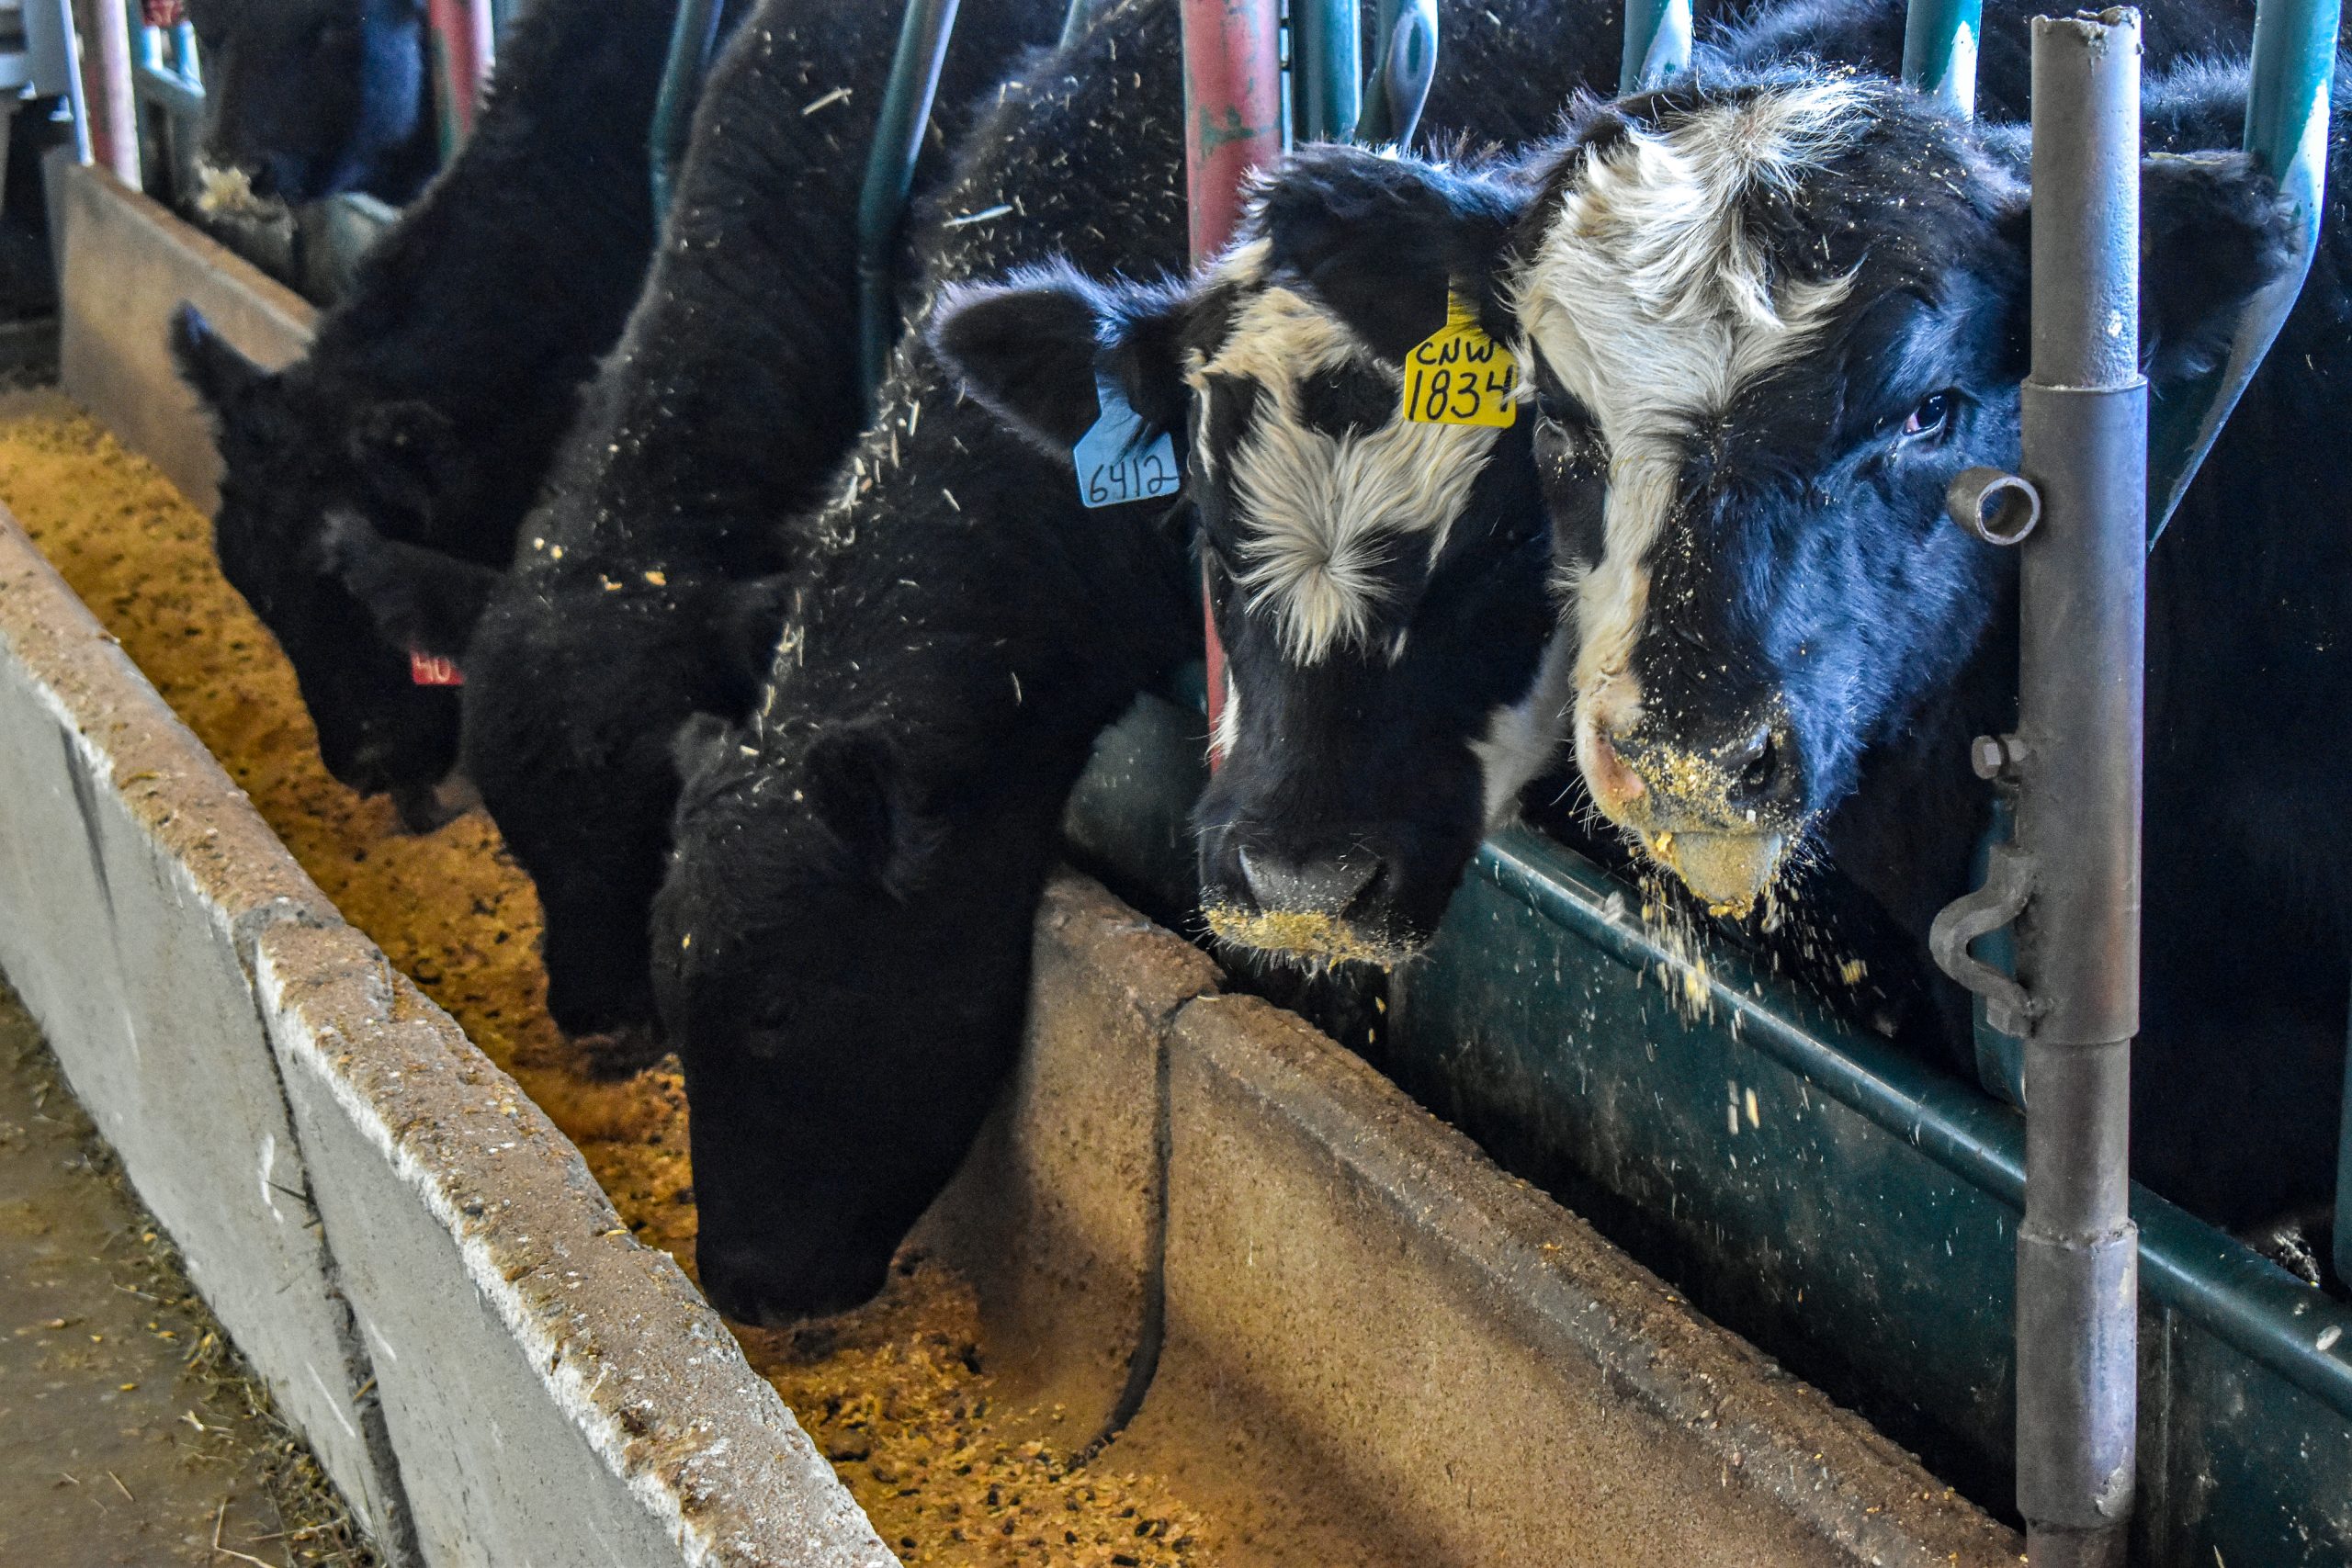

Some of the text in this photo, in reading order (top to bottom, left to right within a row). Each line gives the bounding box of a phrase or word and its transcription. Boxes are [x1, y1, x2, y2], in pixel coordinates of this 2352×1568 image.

[1416, 337, 1494, 366] CNW
[1408, 365, 1513, 421] 1834
[1090, 455, 1178, 503] 6412
